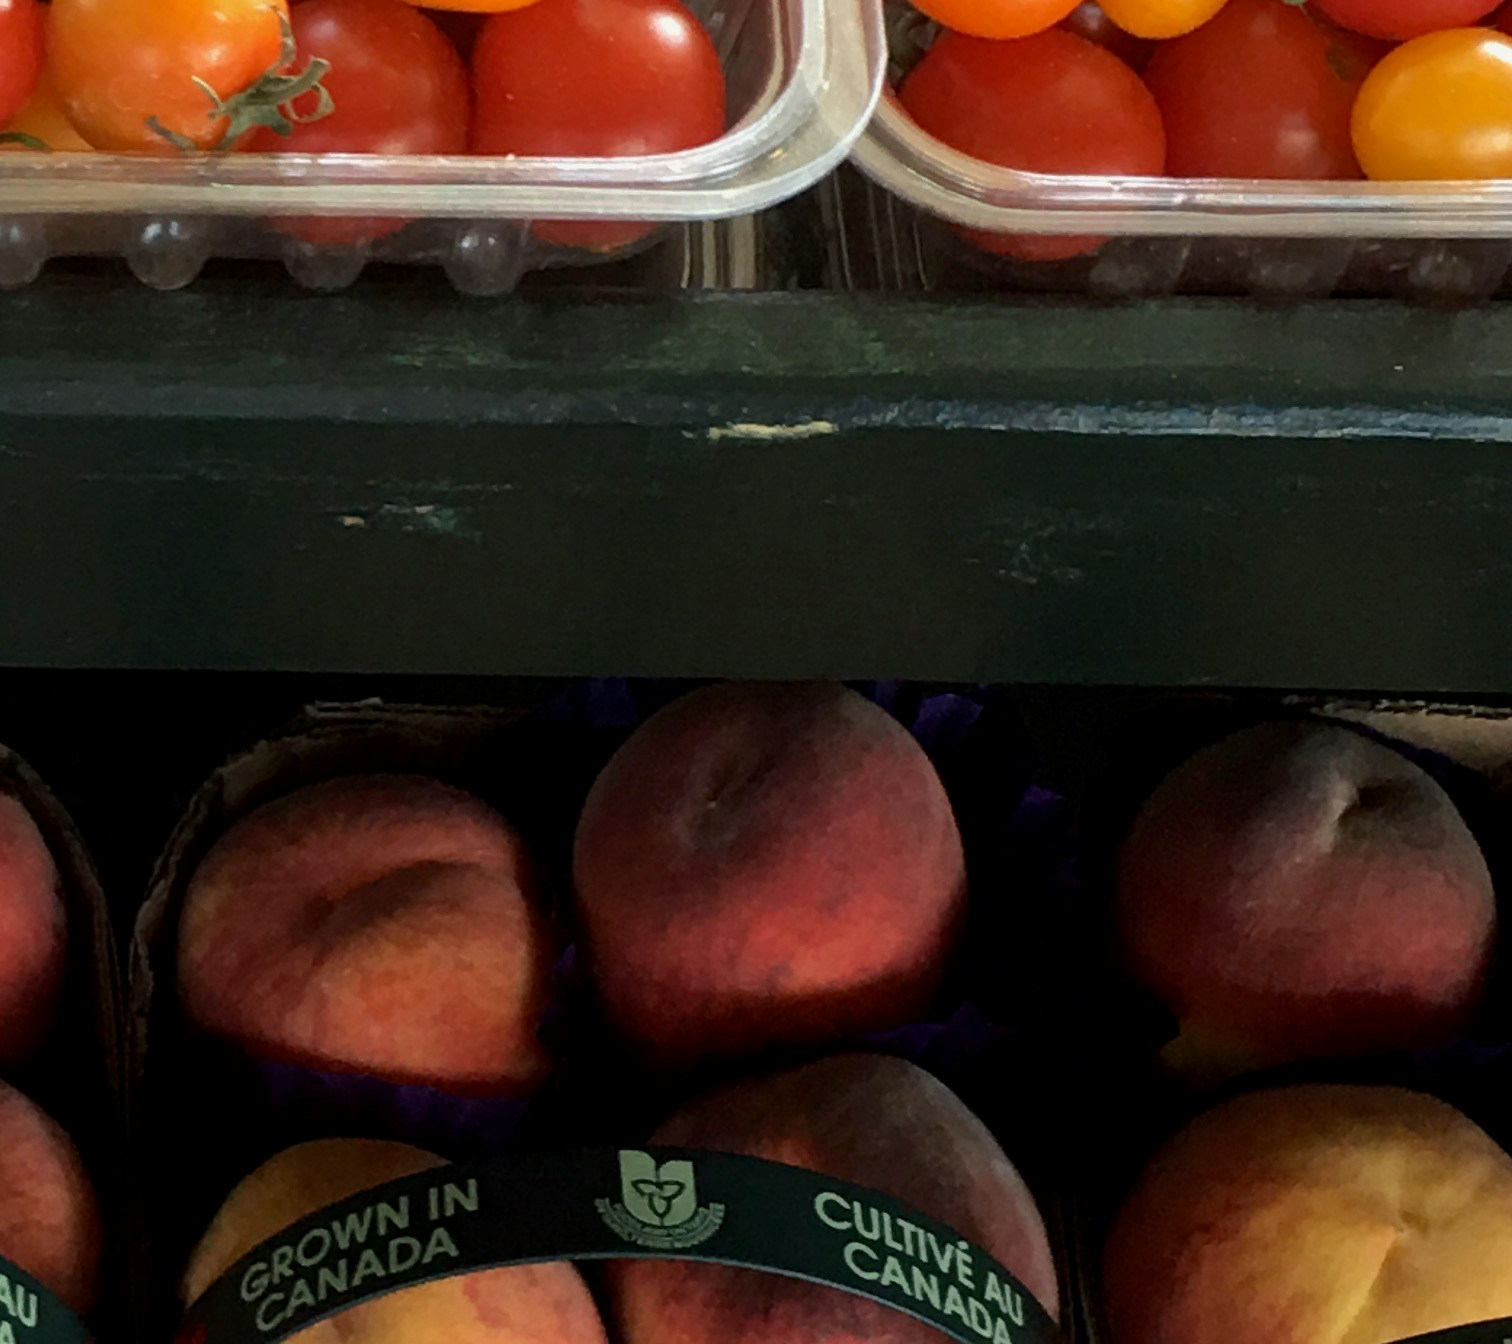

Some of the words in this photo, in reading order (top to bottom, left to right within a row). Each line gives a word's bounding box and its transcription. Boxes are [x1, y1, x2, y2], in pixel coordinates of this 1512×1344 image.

[240, 1195, 410, 1304] GROWN
[428, 1178, 479, 1221] IN
[255, 1226, 460, 1333] CANADA
[813, 1191, 976, 1289] CULTIVÉ
[984, 1269, 1024, 1328] AU
